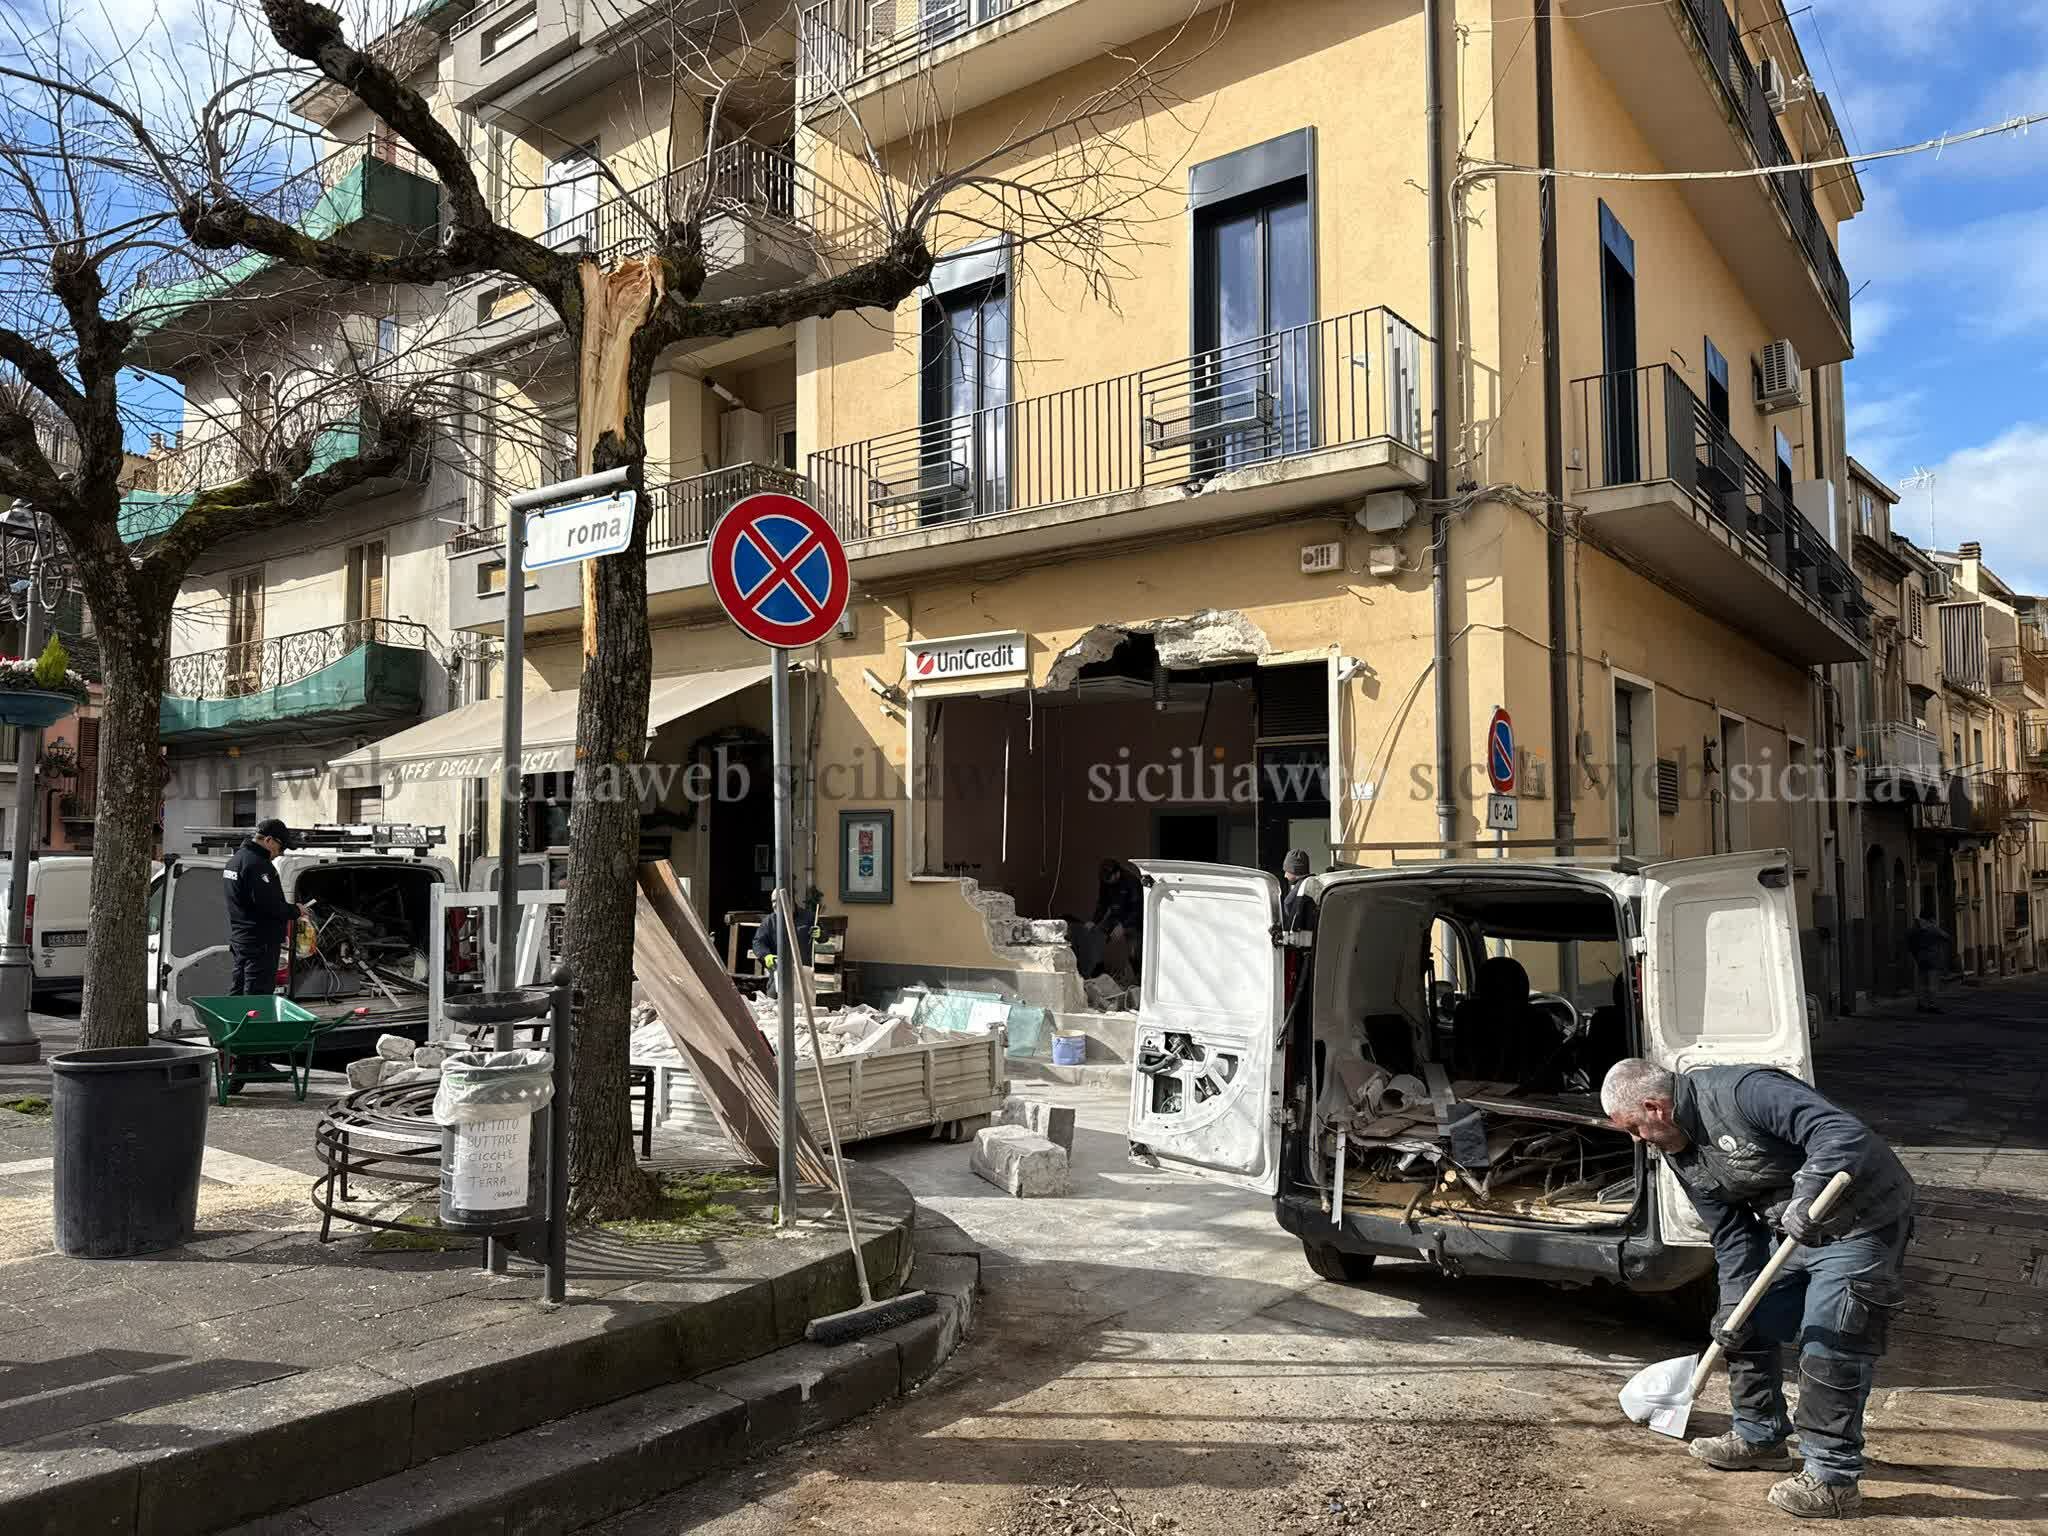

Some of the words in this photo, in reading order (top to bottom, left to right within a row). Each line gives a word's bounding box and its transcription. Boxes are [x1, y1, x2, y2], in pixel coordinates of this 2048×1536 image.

[567, 517, 621, 547] roma
[937, 644, 1014, 672] UniCredit
[439, 757, 484, 777] DEGLI
[490, 750, 560, 774] AISTI
